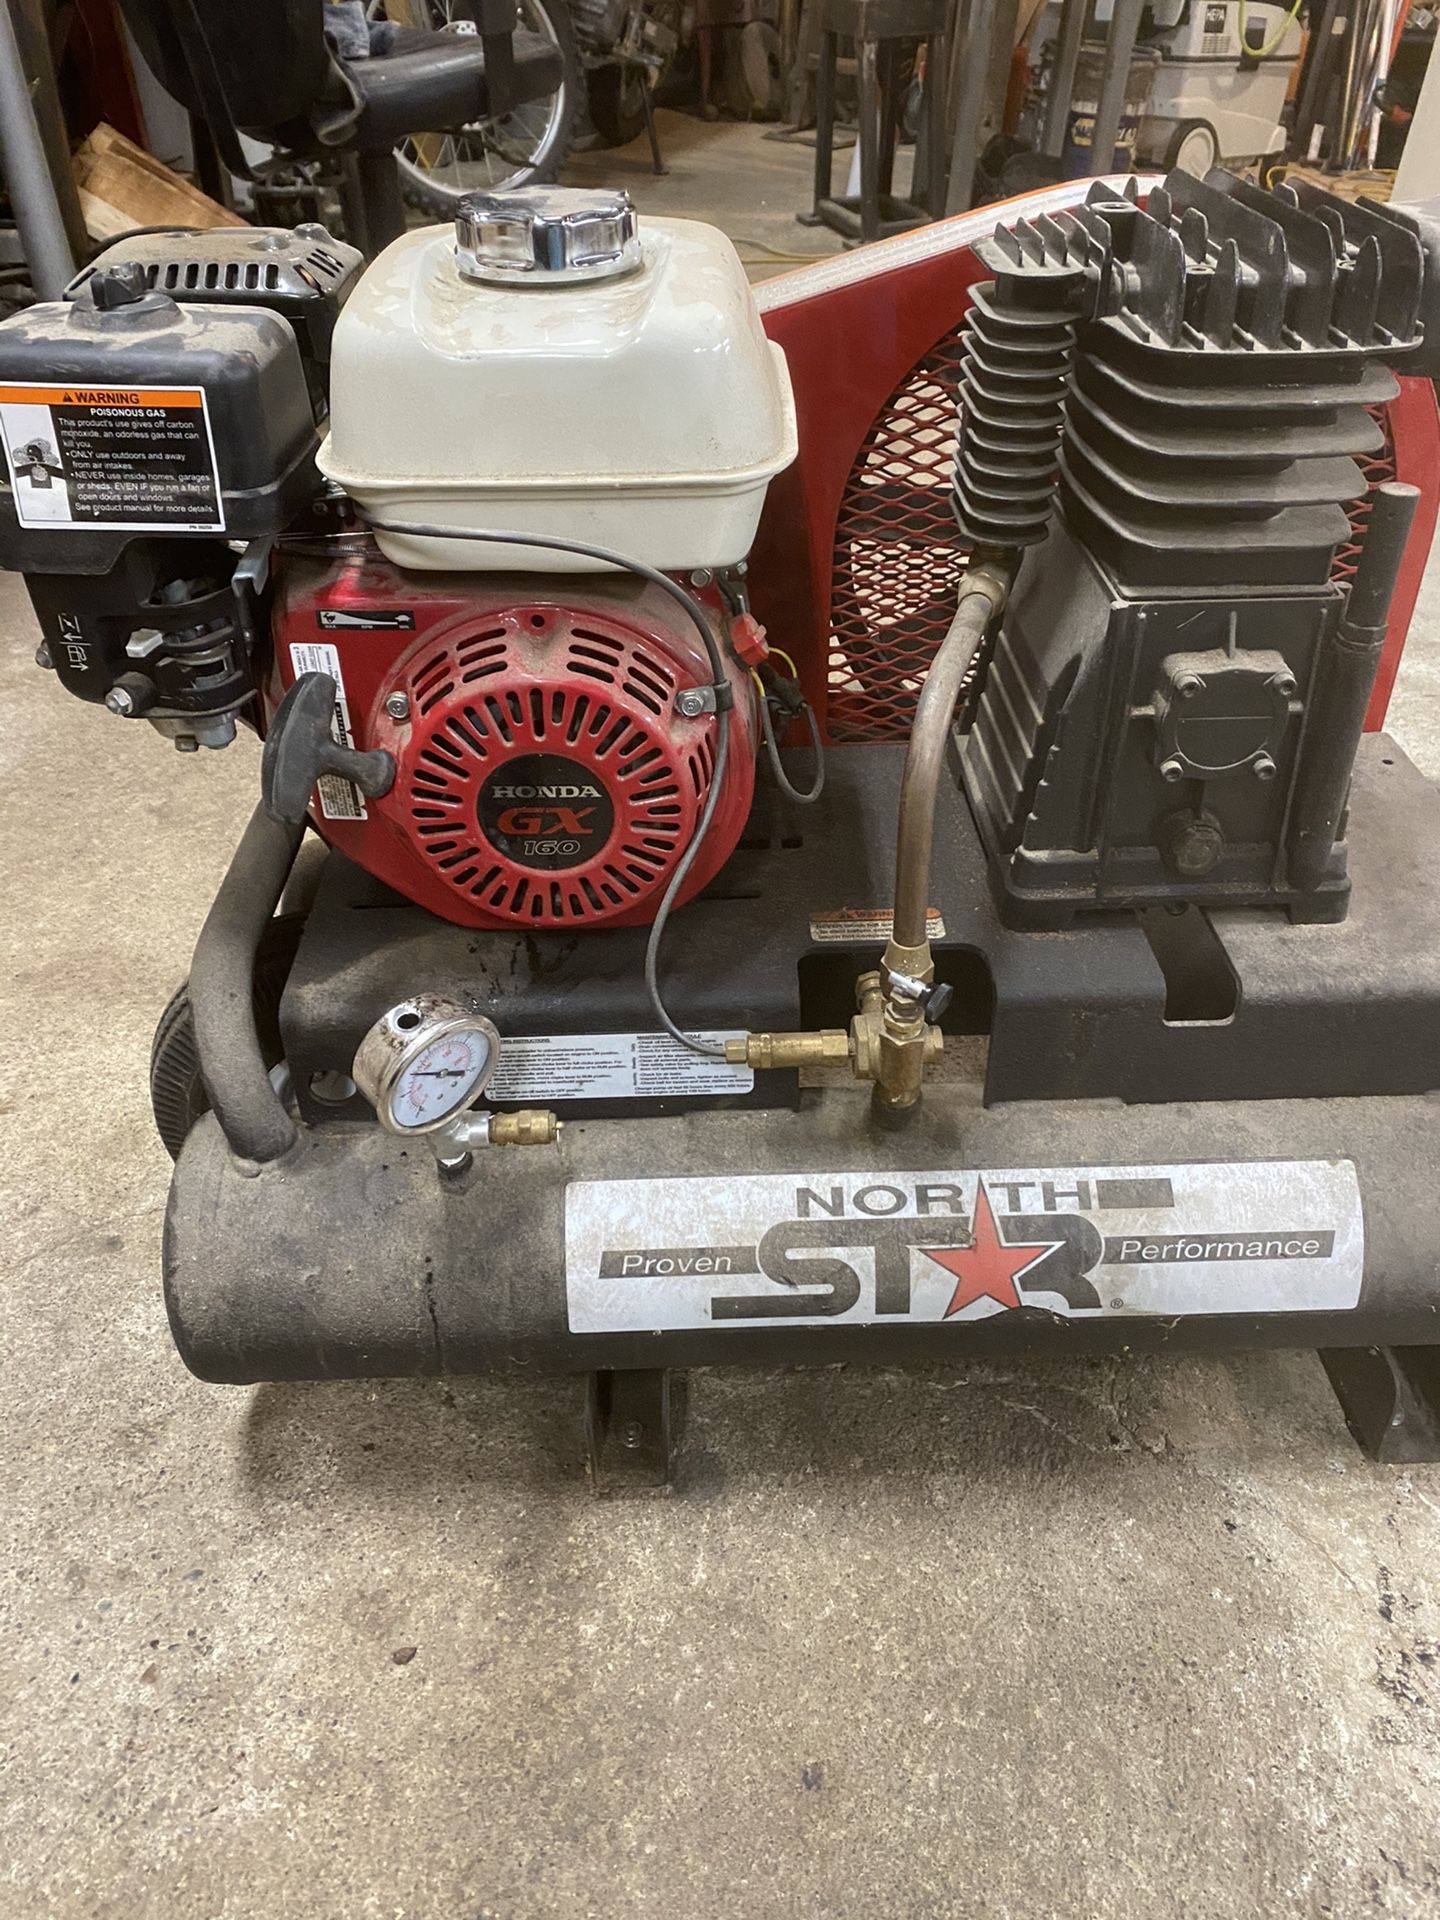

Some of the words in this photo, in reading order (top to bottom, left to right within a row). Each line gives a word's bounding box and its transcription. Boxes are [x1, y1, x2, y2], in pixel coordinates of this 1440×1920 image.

[75, 392, 139, 405] WARNING
[91, 408, 144, 417] POISONOUS
[146, 409, 166, 417] GAS
[59, 418, 75, 427] This
[77, 419, 113, 428] product's
[132, 421, 153, 430] gives
[155, 420, 165, 428] off
[167, 420, 194, 429] carbon
[116, 430, 149, 439] odorless
[151, 432, 165, 441] gas
[167, 431, 182, 439] that
[112, 452, 146, 460] outdoors
[165, 453, 185, 462] away
[72, 461, 91, 469] from
[75, 472, 104, 480] NEVER
[107, 473, 120, 481] use
[123, 472, 146, 481] inside
[178, 474, 210, 484] garages
[115, 483, 138, 491] EVEN
[140, 483, 147, 491] IF
[150, 485, 165, 493] you
[202, 484, 210, 492] or
[78, 494, 97, 504] open
[99, 493, 121, 502] doors
[123, 493, 138, 502] and
[75, 503, 91, 511] See
[93, 503, 121, 514] product
[123, 503, 152, 512] manual
[154, 504, 164, 512] for
[166, 505, 186, 513] more
[492, 785, 602, 798] HONDA
[497, 806, 598, 835] GX
[523, 839, 581, 856] 160
[795, 1177, 1092, 1219] NORTH
[1120, 1237, 1320, 1260] Performance
[621, 1252, 732, 1276] Proven
[711, 1214, 1104, 1323] STAR
